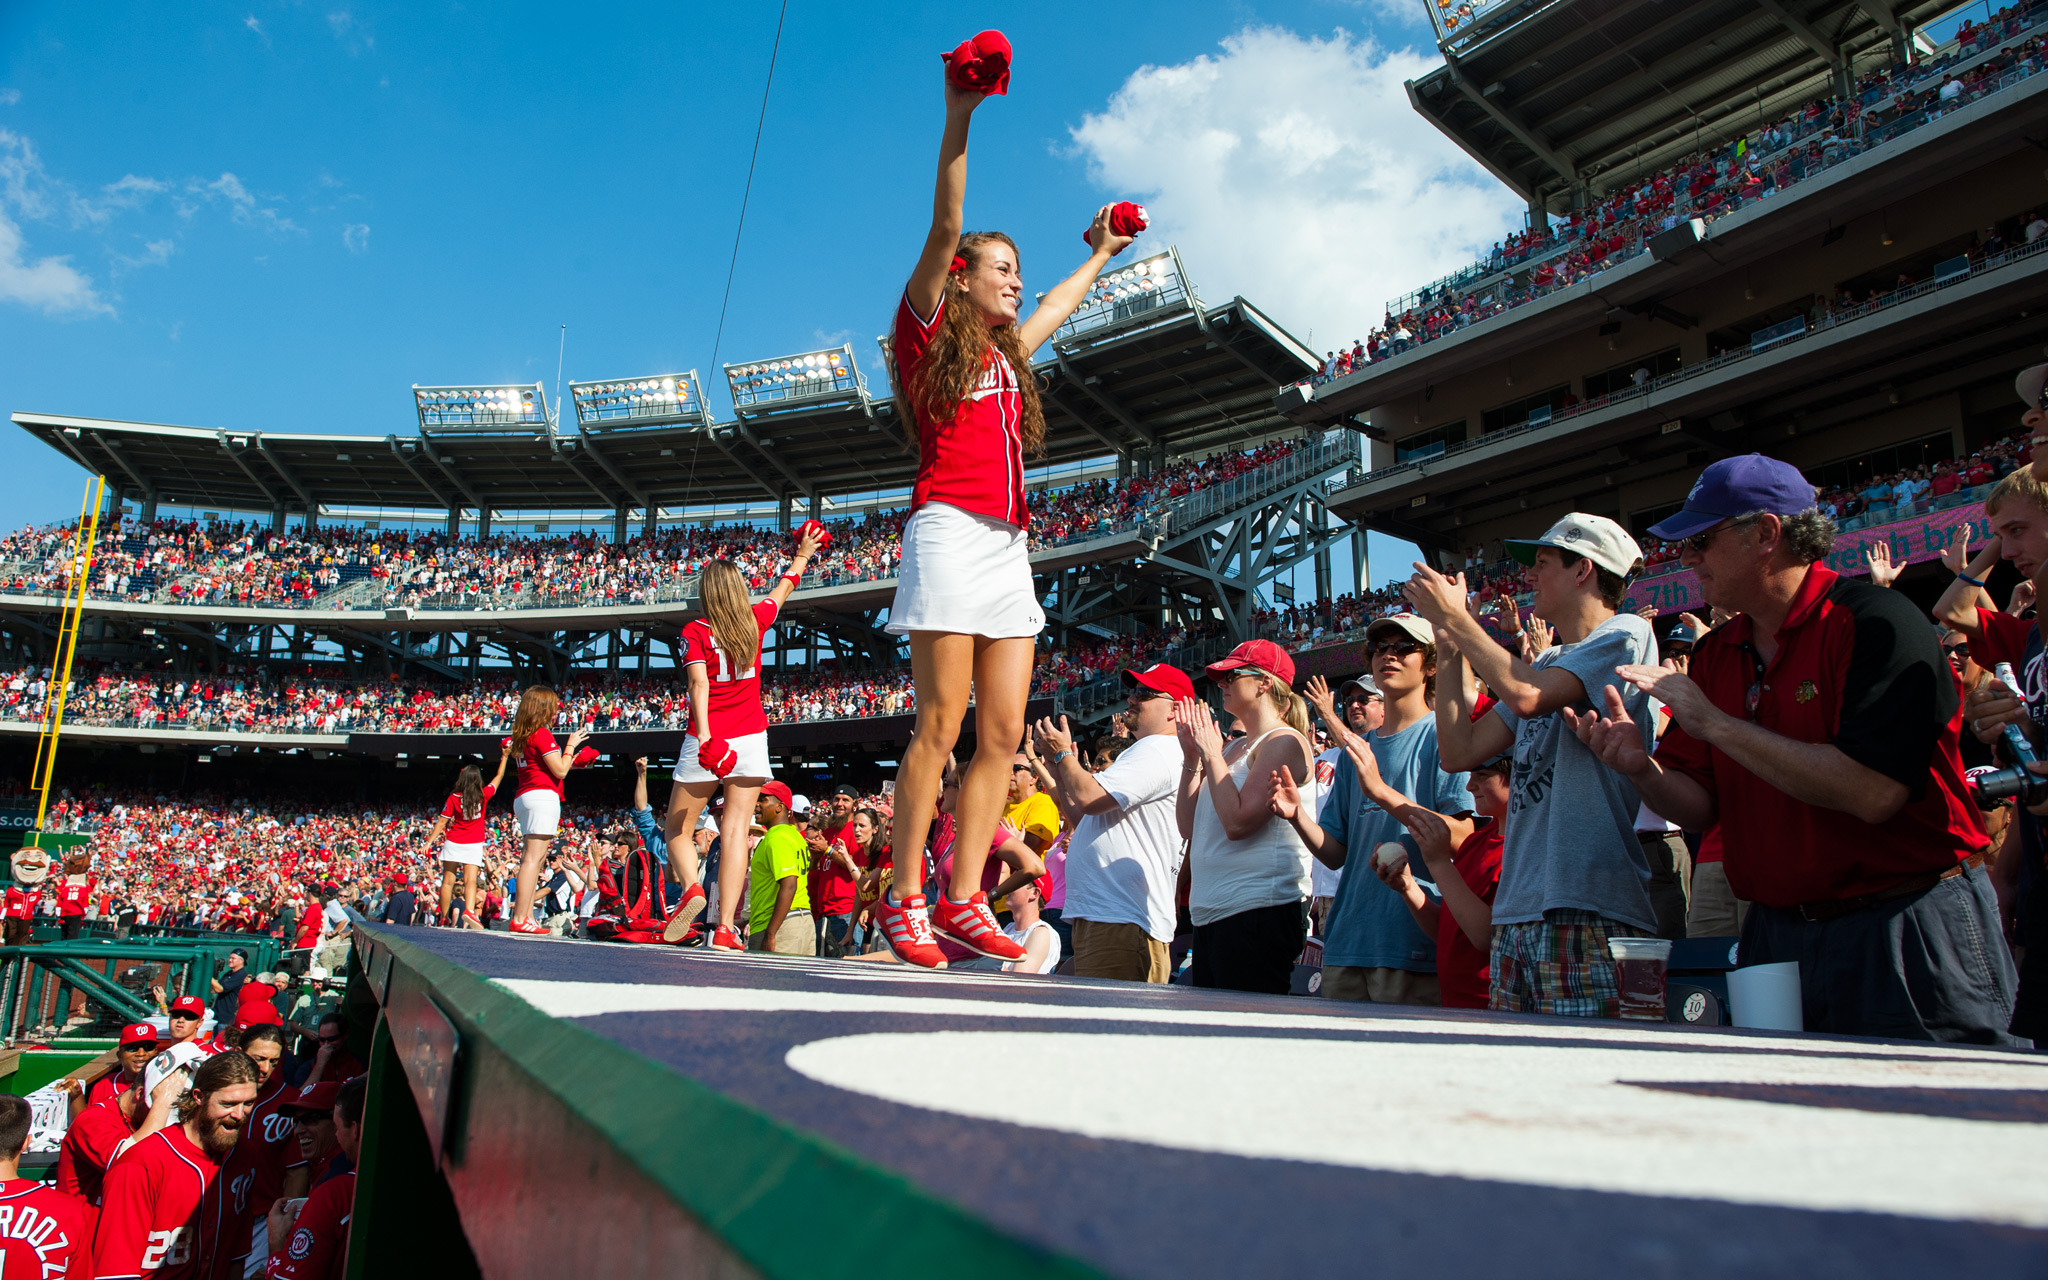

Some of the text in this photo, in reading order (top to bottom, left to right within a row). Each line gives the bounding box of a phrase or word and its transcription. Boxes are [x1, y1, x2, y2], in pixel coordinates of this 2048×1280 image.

[1664, 422, 1678, 432] 220
[1414, 496, 1424, 506] 221
[1646, 581, 1688, 609] 7th
[1688, 1001, 1702, 1013] 10
[141, 1226, 194, 1270] 28
